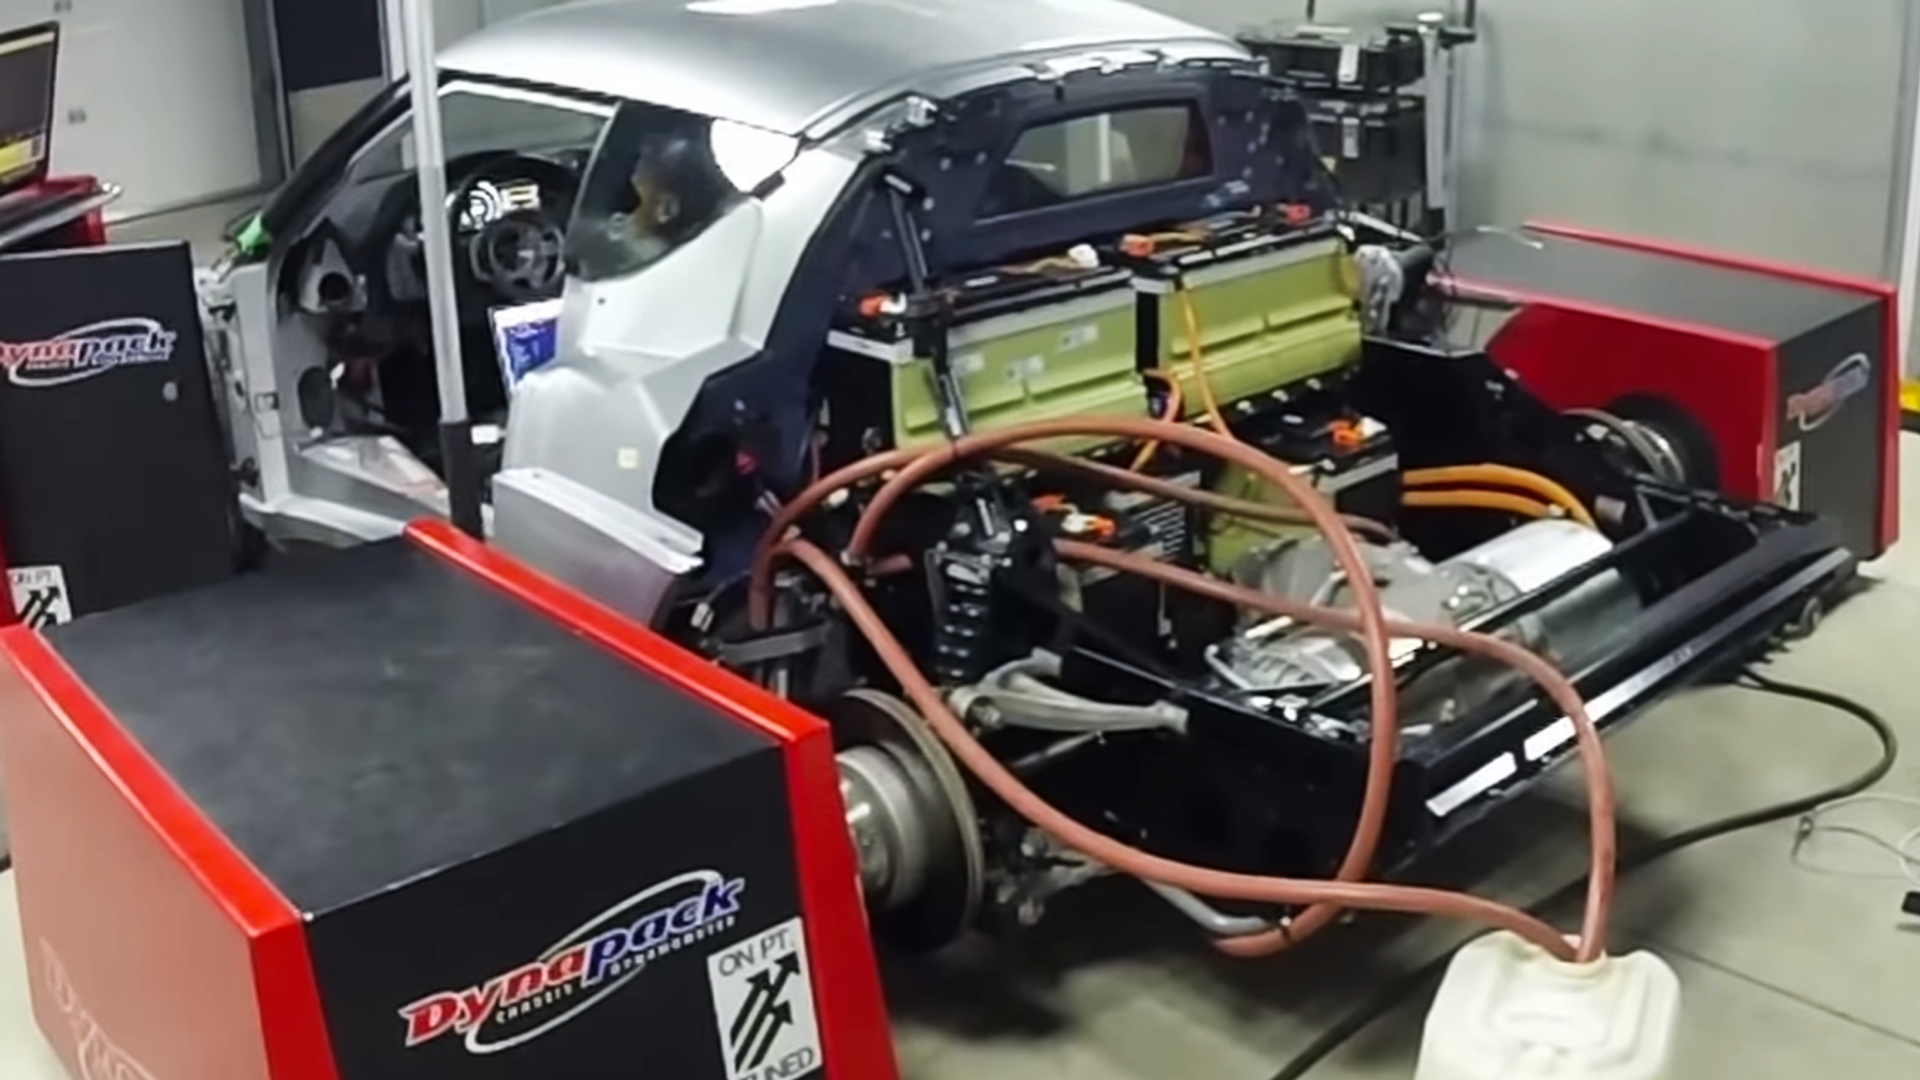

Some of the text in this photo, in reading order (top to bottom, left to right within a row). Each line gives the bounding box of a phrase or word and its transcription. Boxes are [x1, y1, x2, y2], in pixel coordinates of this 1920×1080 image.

[0, 331, 177, 368] ynapack
[397, 877, 746, 1047] Dynapack
[718, 943, 756, 977] ON
[739, 1045, 815, 1080] NED
